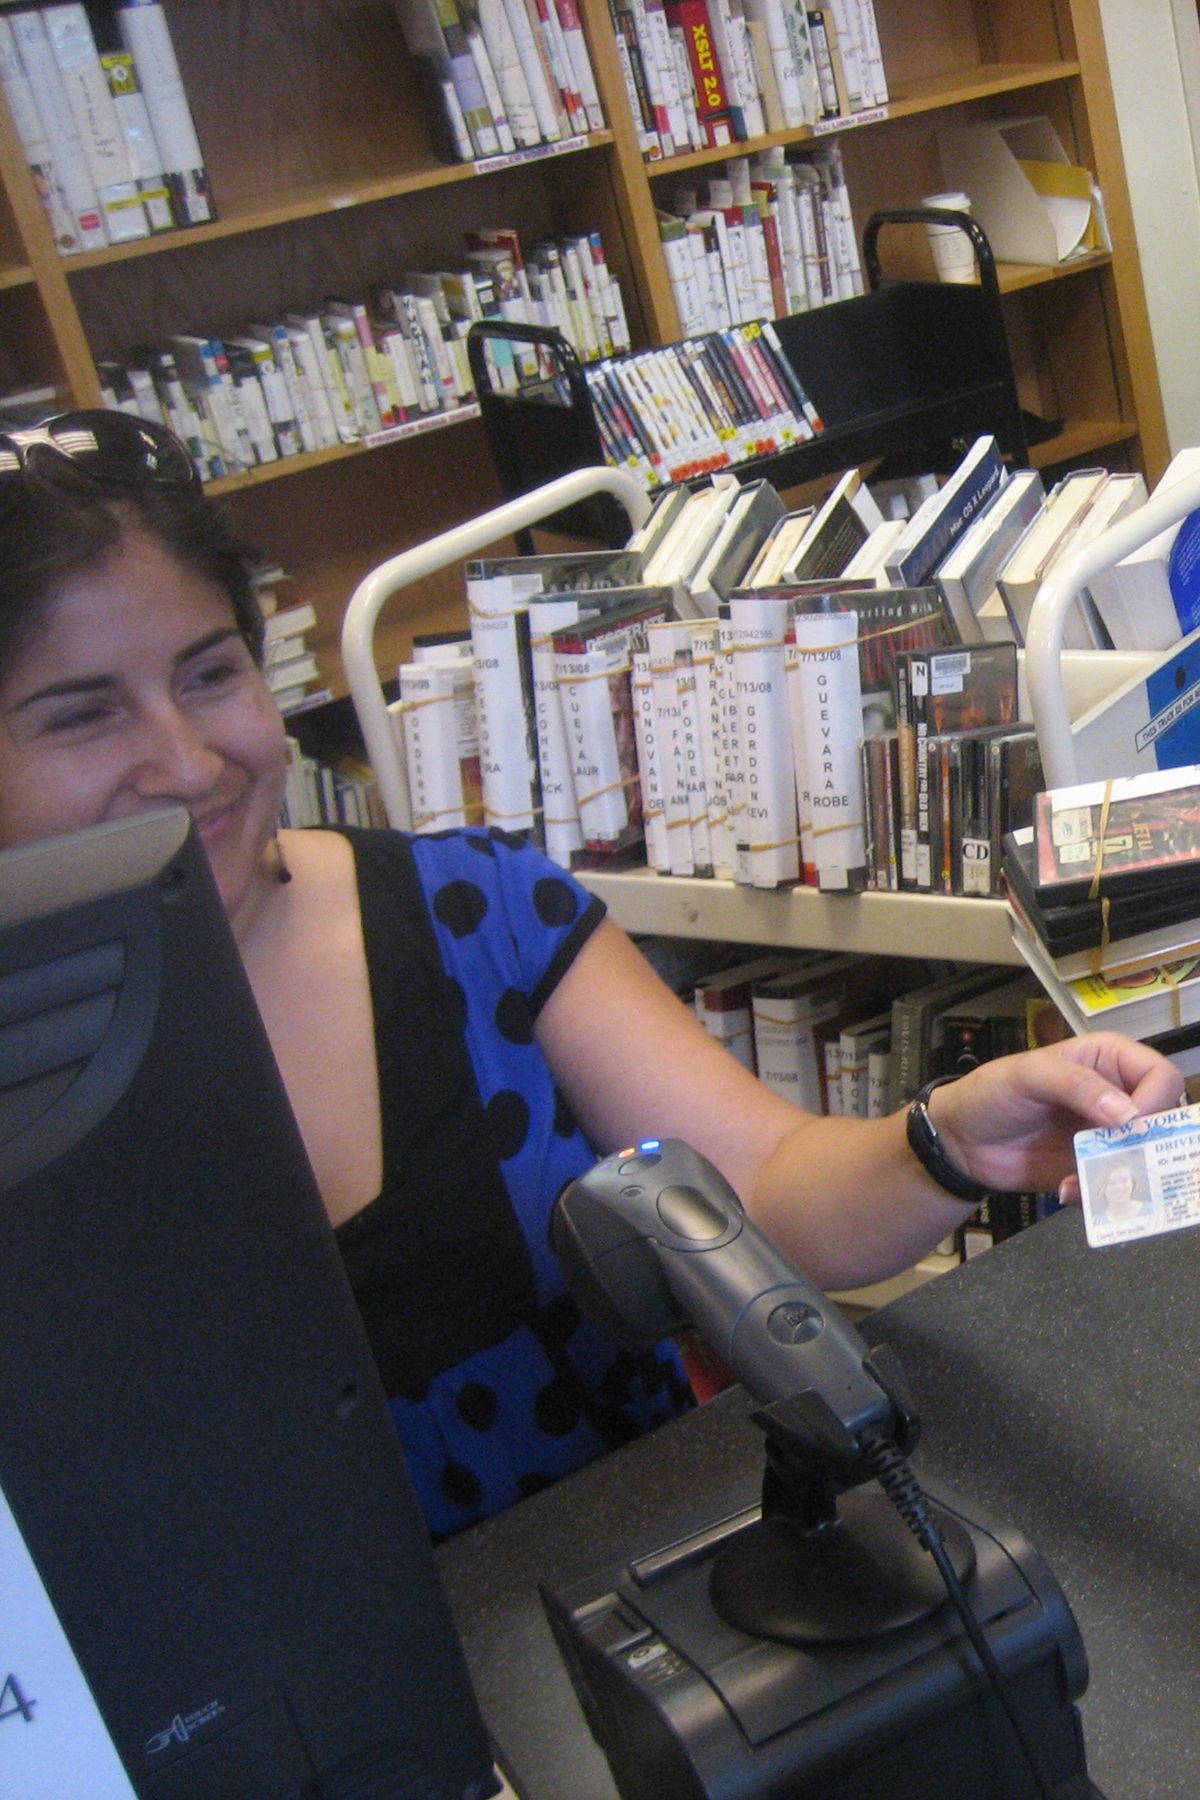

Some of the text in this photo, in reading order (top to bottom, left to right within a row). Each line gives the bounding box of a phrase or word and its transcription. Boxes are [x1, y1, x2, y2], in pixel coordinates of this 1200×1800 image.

[692, 23, 722, 107] XSLT 2.0
[963, 502, 974, 518] OS
[976, 464, 999, 500] Leopard
[801, 650, 842, 662] 7/13/08
[411, 702, 426, 806] ORDERS
[538, 703, 552, 778] COHEN
[569, 686, 586, 761] CUEVA
[682, 700, 697, 777] FORDE
[747, 706, 758, 801] GORDON
[817, 675, 834, 790] GUEVARA
[813, 793, 849, 808] ROBE
[918, 792, 929, 811] OLD
[962, 842, 989, 860] CD
[1093, 1122, 1135, 1141] NEW
[1143, 1108, 1191, 1131] YORK
[0, 1673, 37, 1723] 4
